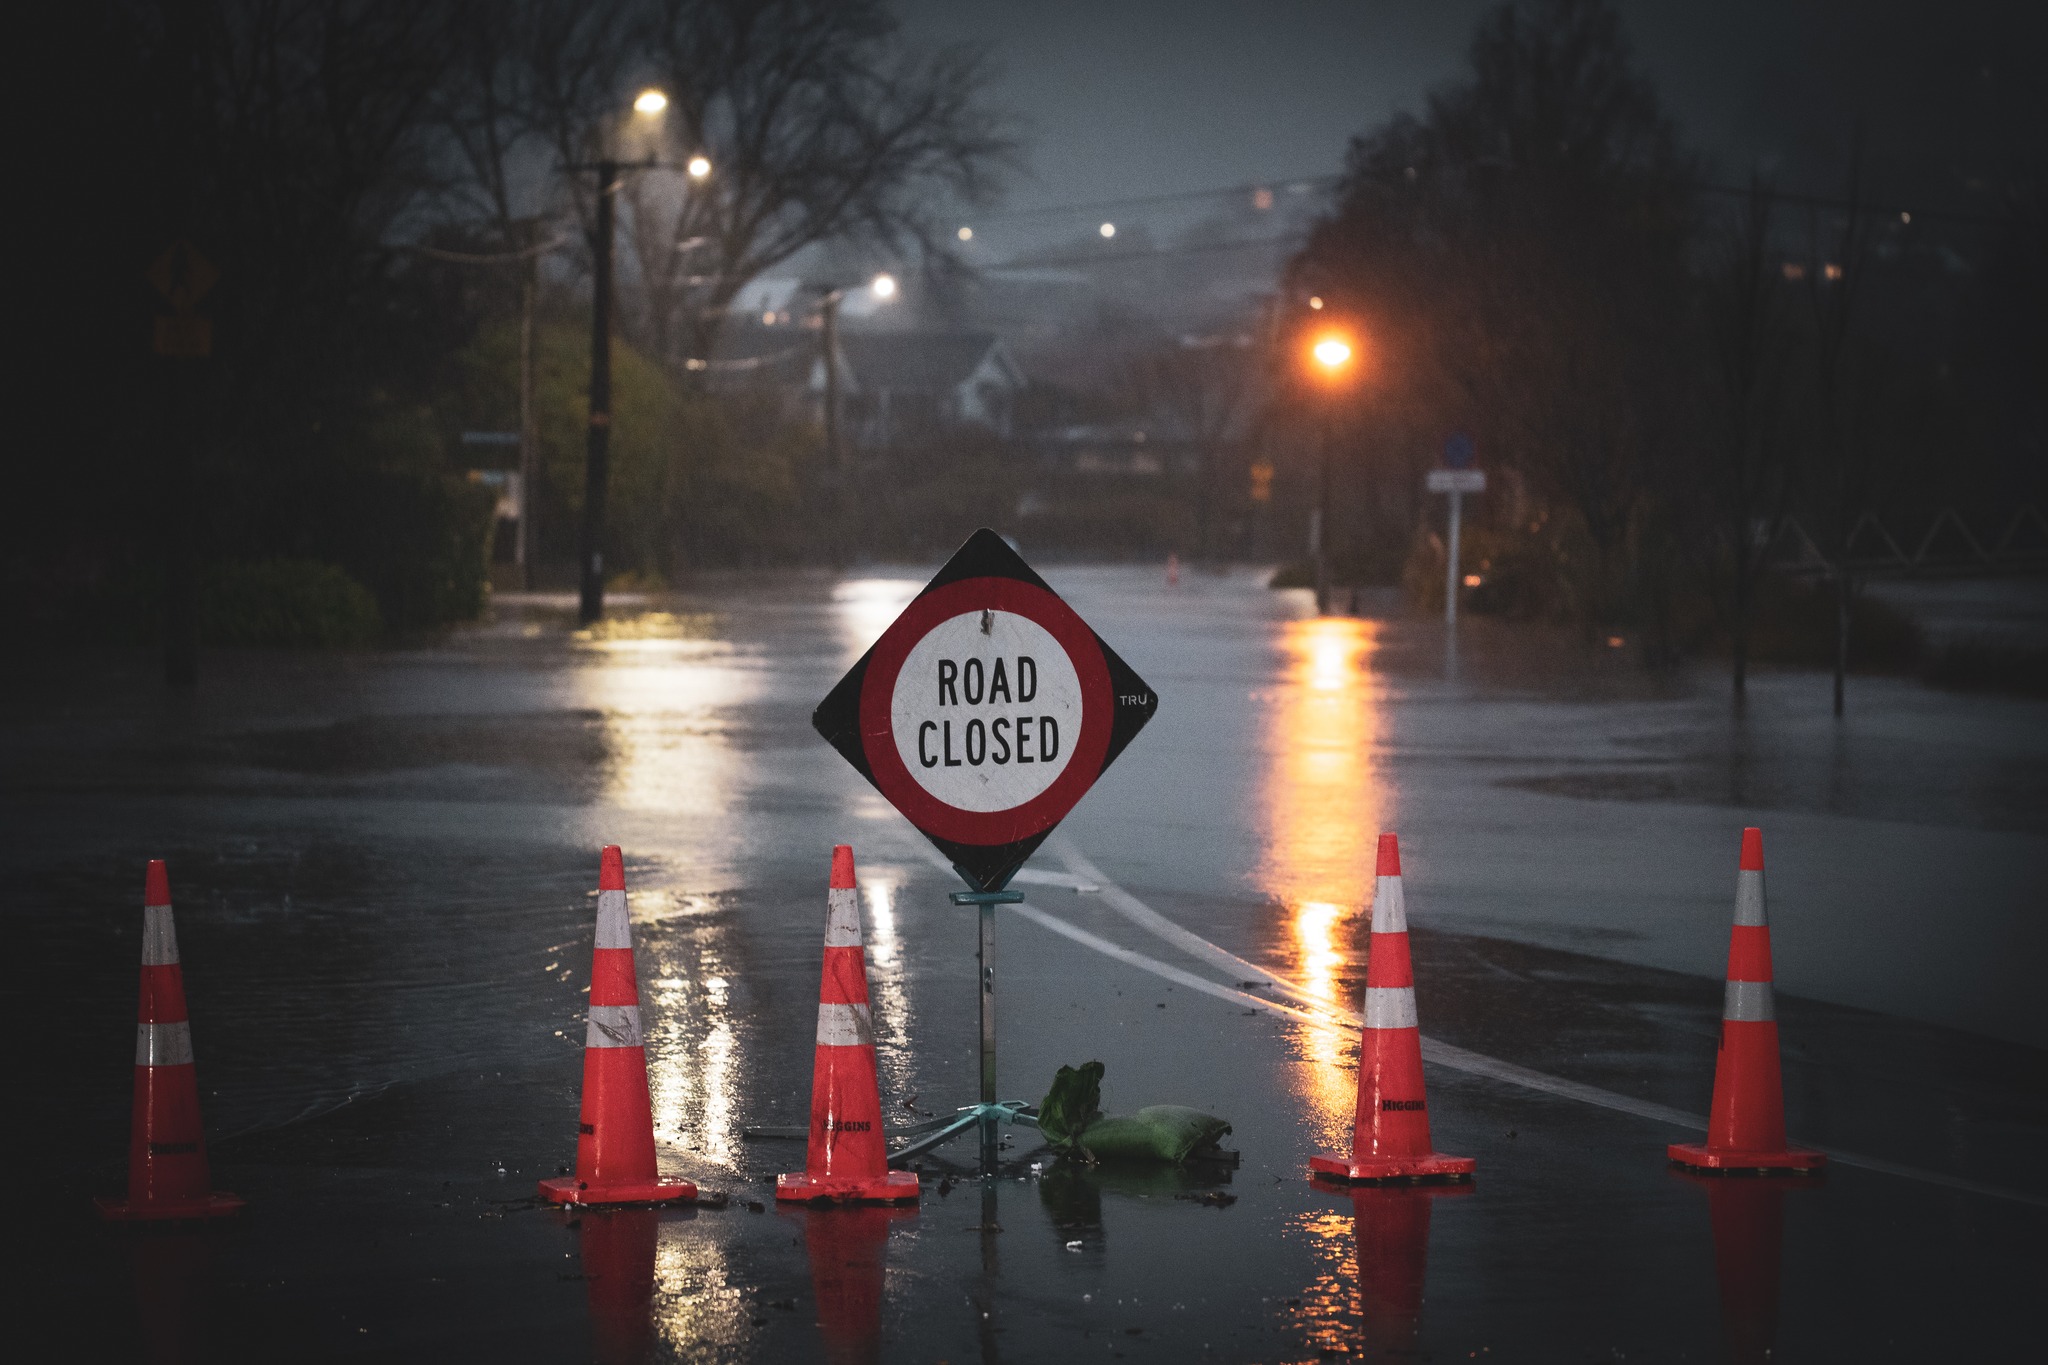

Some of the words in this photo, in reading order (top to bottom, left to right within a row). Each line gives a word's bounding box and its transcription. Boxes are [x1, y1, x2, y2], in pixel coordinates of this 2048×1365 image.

[938, 656, 1038, 707] ROAD
[1119, 693, 1148, 706] TRU
[918, 715, 1060, 768] CLOSED
